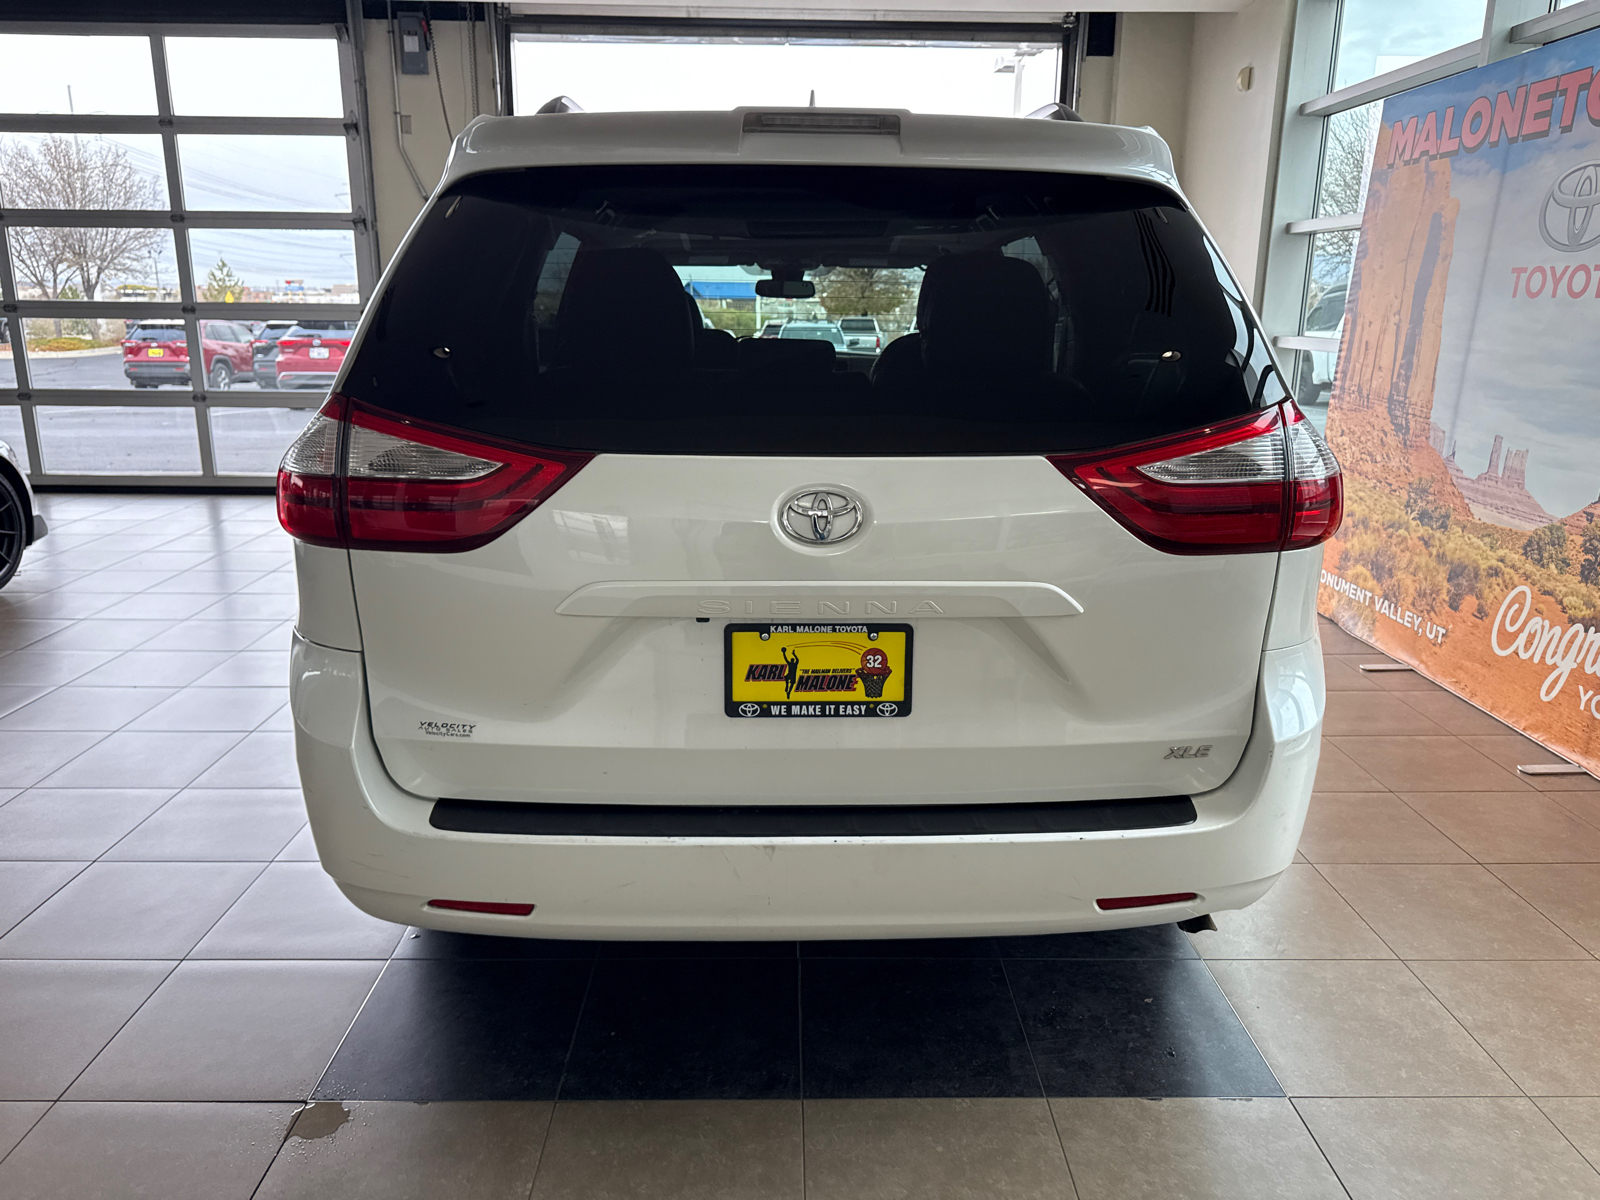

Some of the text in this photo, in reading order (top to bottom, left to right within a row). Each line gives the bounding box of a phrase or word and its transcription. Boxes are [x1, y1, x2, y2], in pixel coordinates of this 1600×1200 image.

[697, 600, 945, 615] SIENNA
[1320, 569, 1446, 643] ONUMENT VALLEY, UT
[770, 625, 868, 633] KARL MALONE TOYOTA
[866, 655, 882, 668] 32
[745, 664, 787, 682] KARL
[794, 674, 858, 692] MALONE
[771, 705, 866, 715] WE MAKE IT EASY
[419, 721, 477, 729] VELOCITY
[1163, 744, 1213, 760] XLE
